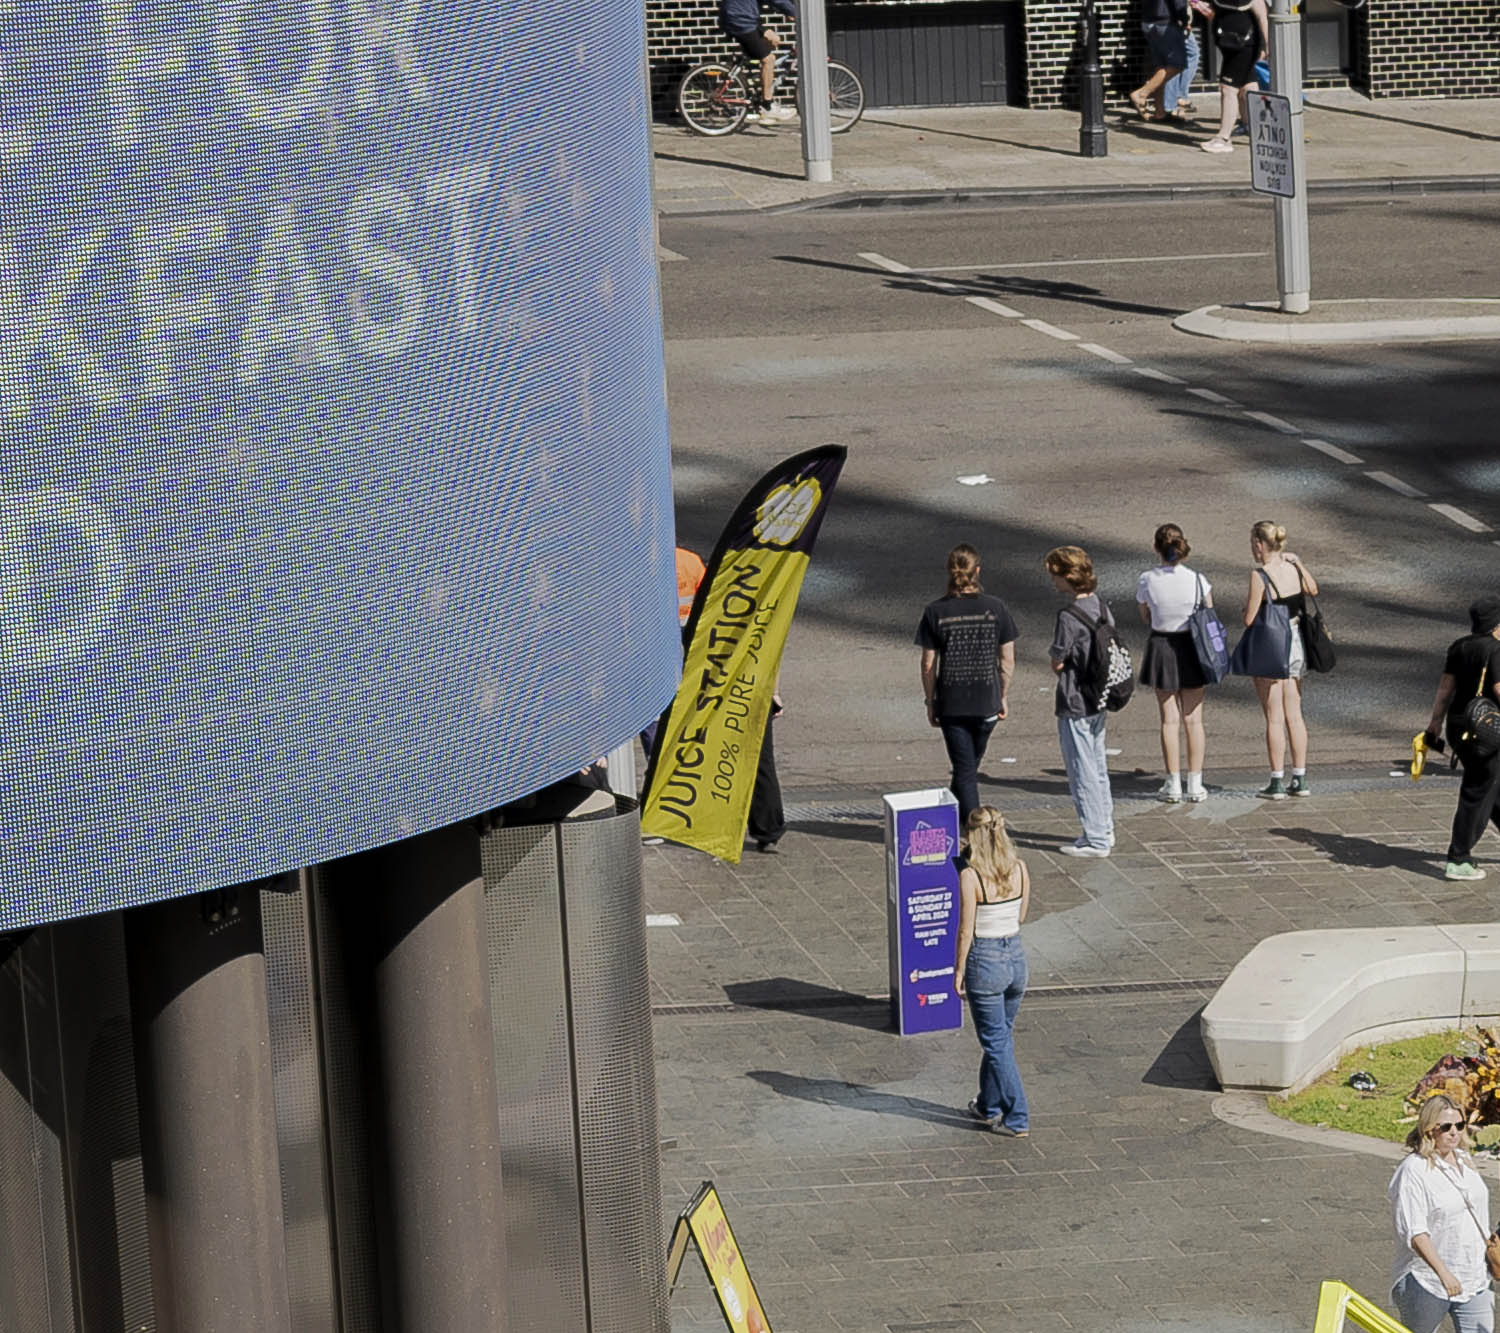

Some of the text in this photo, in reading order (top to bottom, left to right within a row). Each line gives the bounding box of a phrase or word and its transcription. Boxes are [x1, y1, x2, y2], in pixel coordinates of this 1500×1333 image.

[660, 562, 763, 829] JUICE STATION
[724, 672, 757, 734] PURE
[711, 740, 741, 804] 100%
